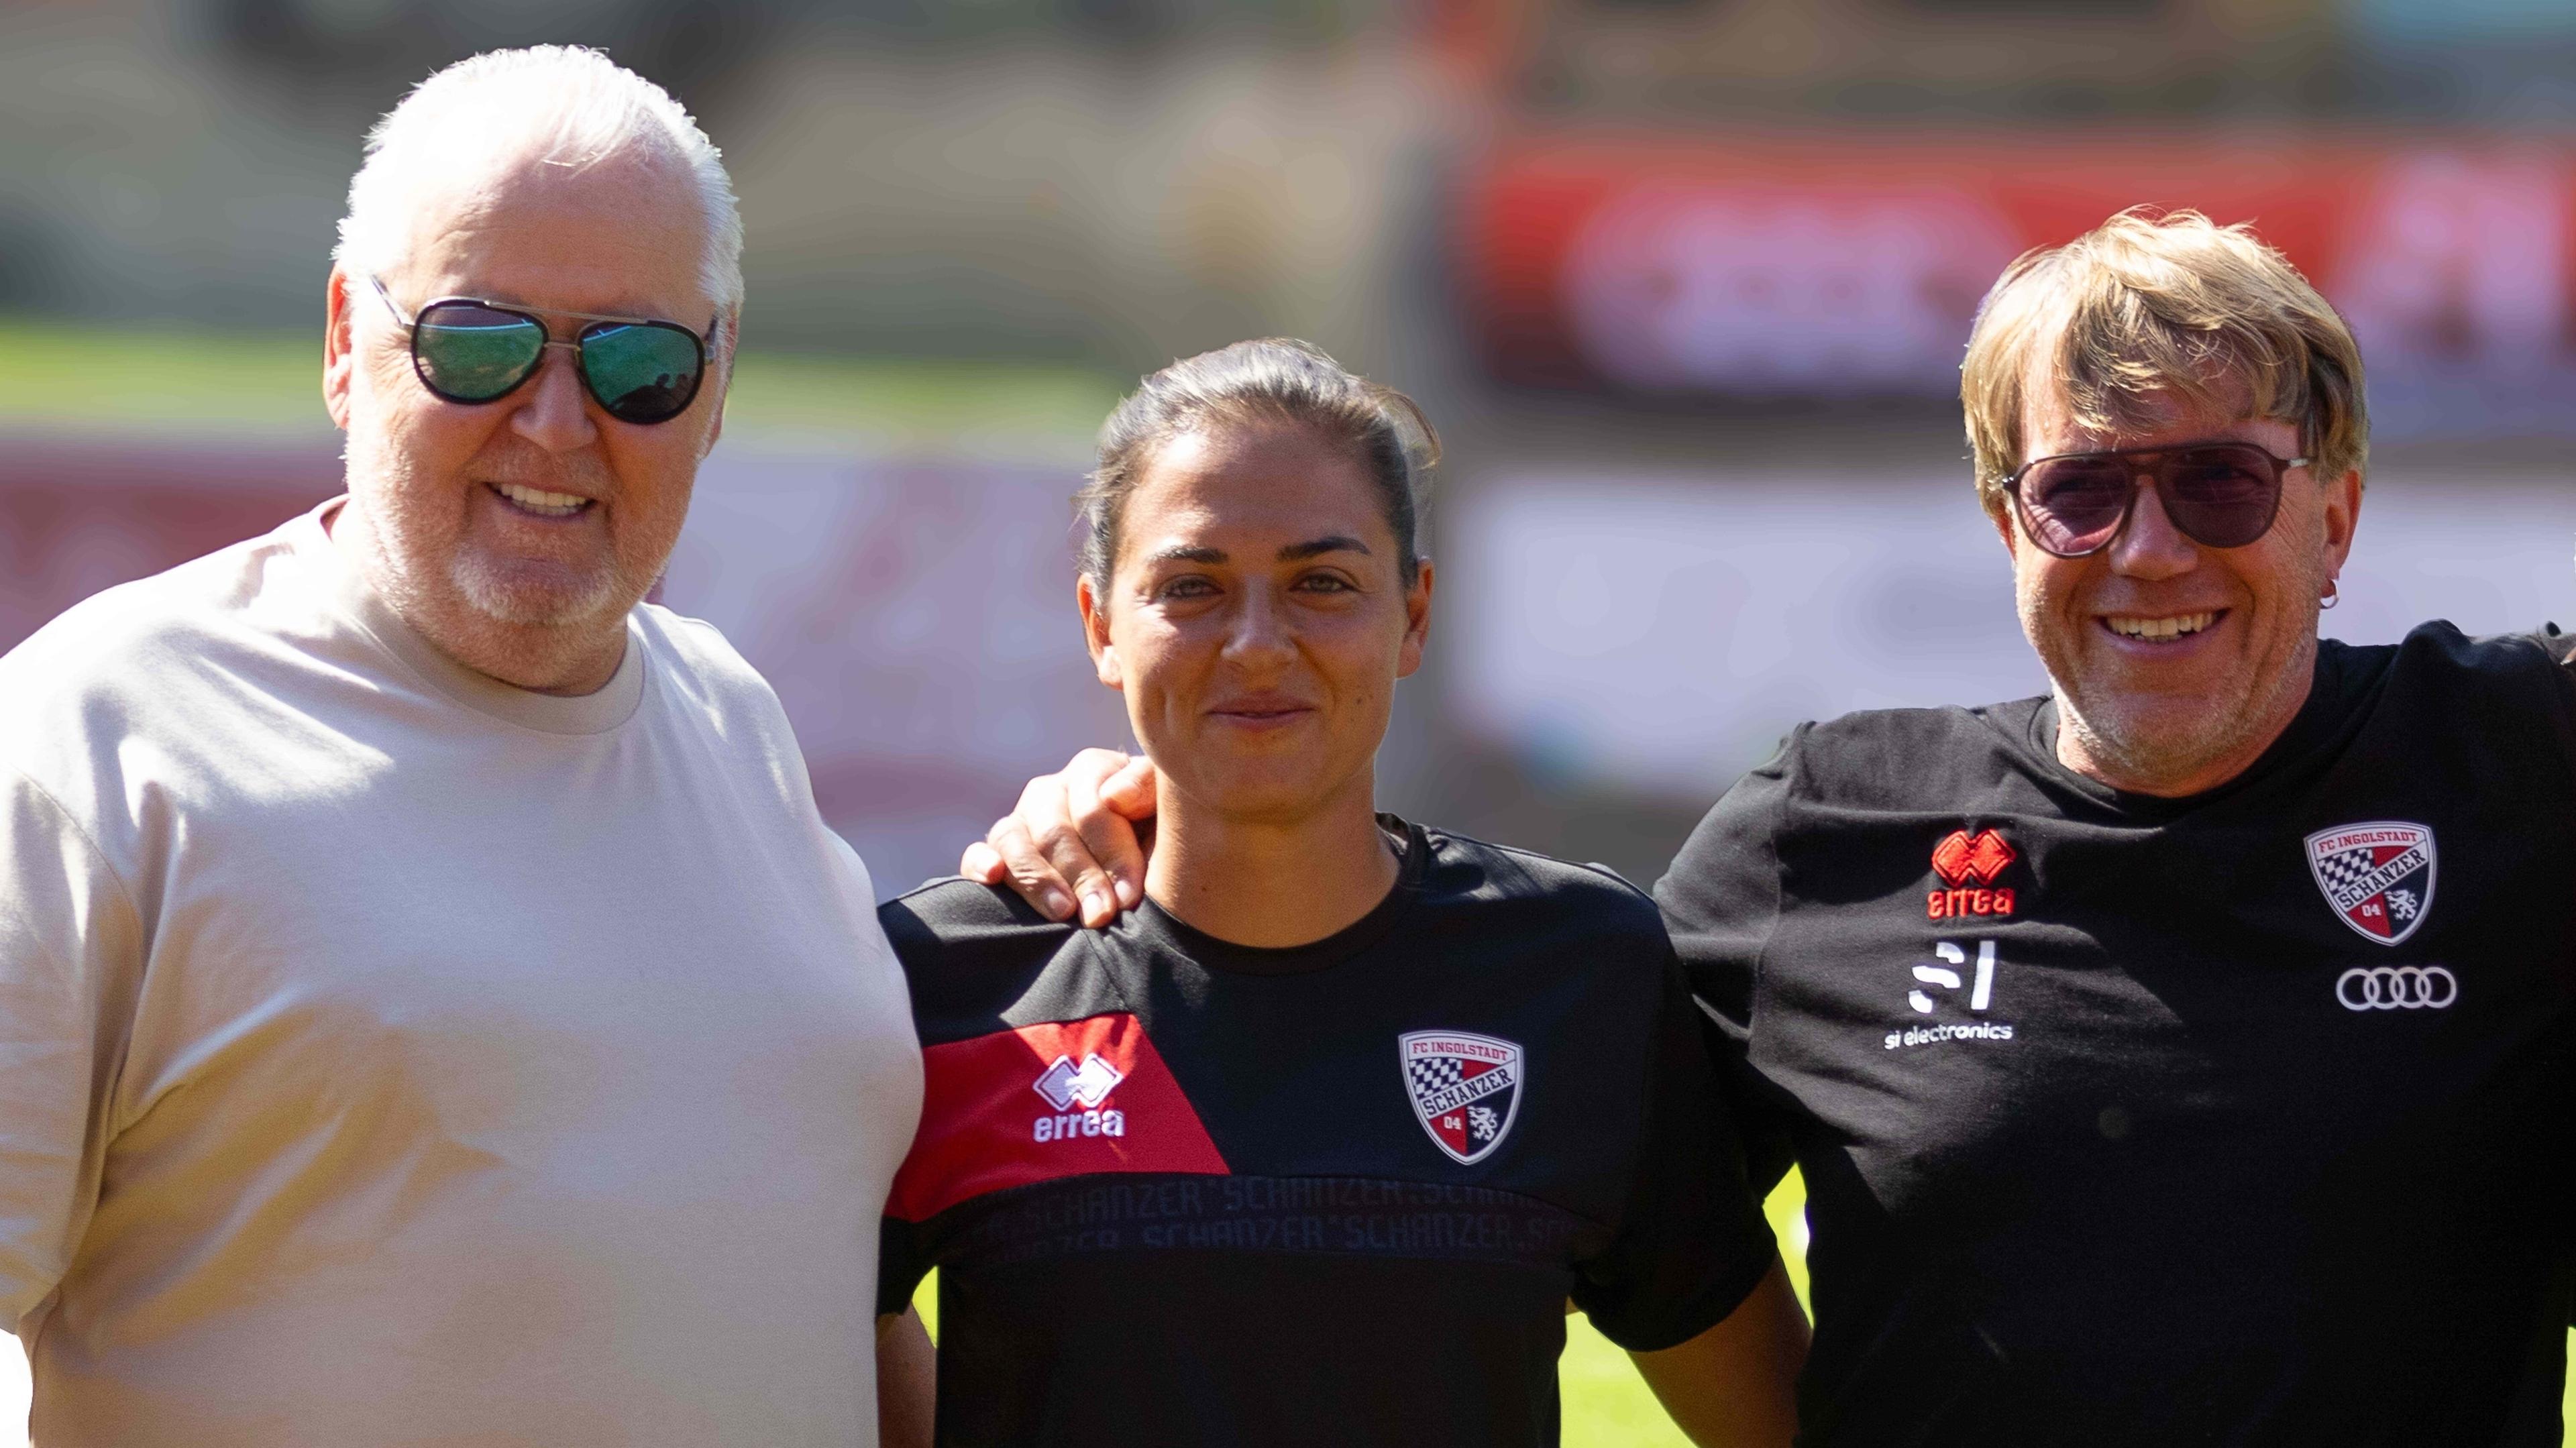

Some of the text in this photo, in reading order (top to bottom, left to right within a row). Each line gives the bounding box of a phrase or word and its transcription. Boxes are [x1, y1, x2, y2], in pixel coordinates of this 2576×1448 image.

[2318, 832, 2418, 853] FC INGOLSTADT
[2338, 848, 2426, 908] SCHANZER
[2361, 903, 2382, 917] 04
[1884, 1022, 2013, 1050] si electronics
[1412, 1042, 1508, 1061] FC INGOLSTADT
[1422, 1068, 1513, 1116] SCHANZER
[1443, 1115, 1462, 1130] 04
